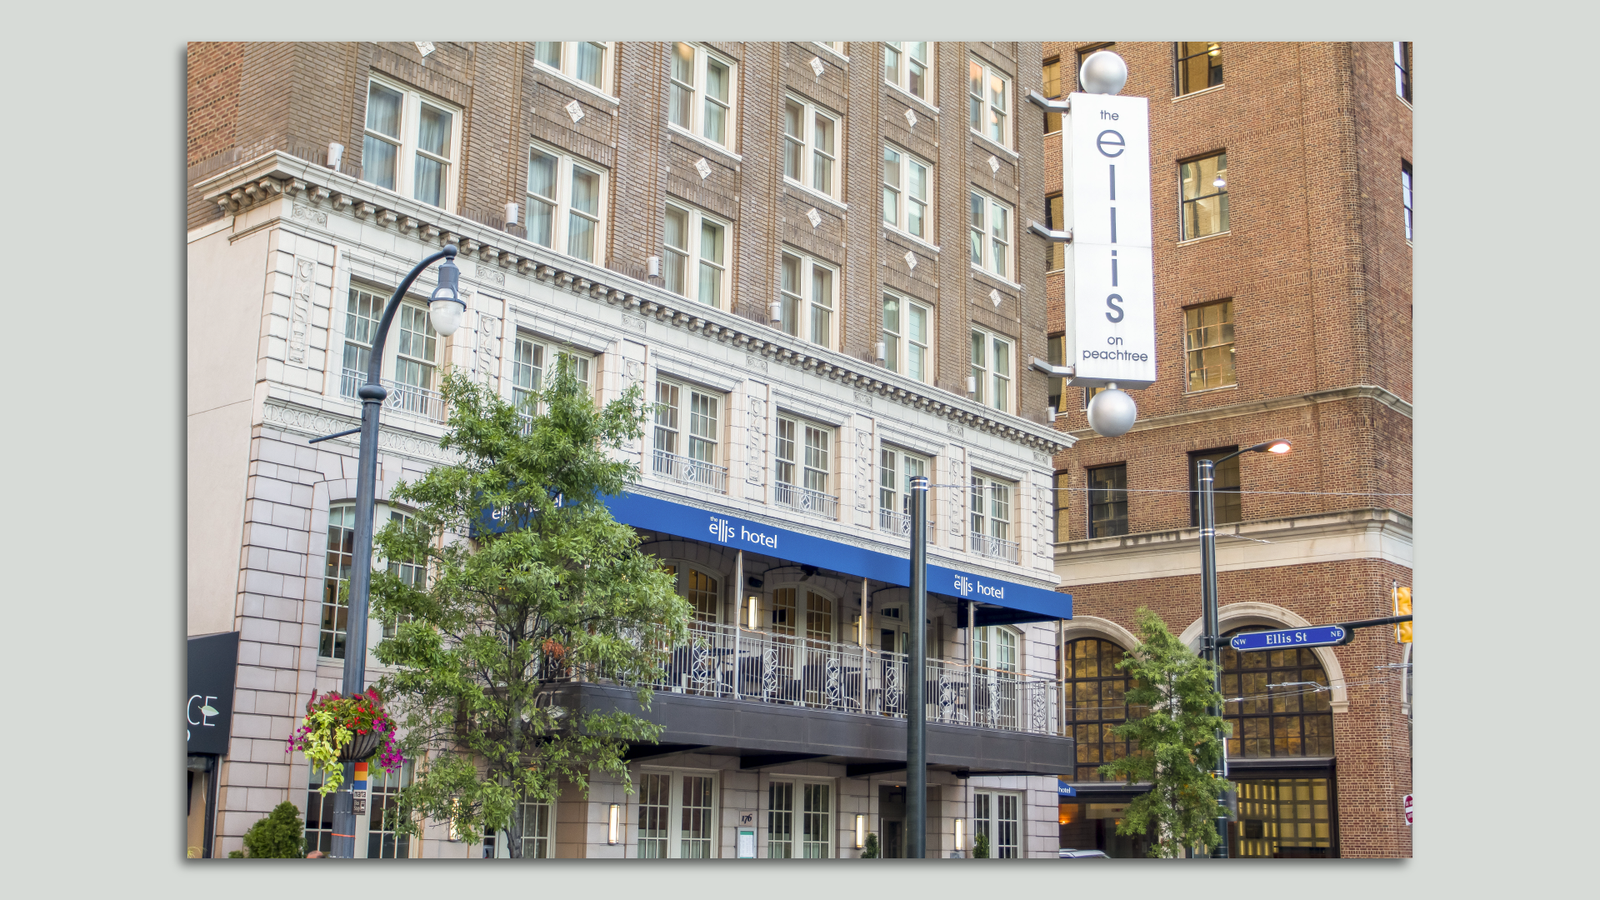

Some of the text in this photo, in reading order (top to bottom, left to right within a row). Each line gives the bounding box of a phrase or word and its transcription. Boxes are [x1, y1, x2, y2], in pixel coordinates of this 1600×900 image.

[1100, 109, 1119, 121] the
[1096, 129, 1126, 324] ellis
[1107, 336, 1123, 345] on
[1082, 350, 1148, 362] peachtree
[708, 518, 778, 549] ellis hotel
[953, 576, 1004, 599] ellis hotel
[1233, 638, 1247, 646] NW
[1265, 633, 1292, 645] Ellis
[1295, 631, 1308, 642] St
[1058, 786, 1071, 794] hotel
[741, 813, 753, 824] 176
